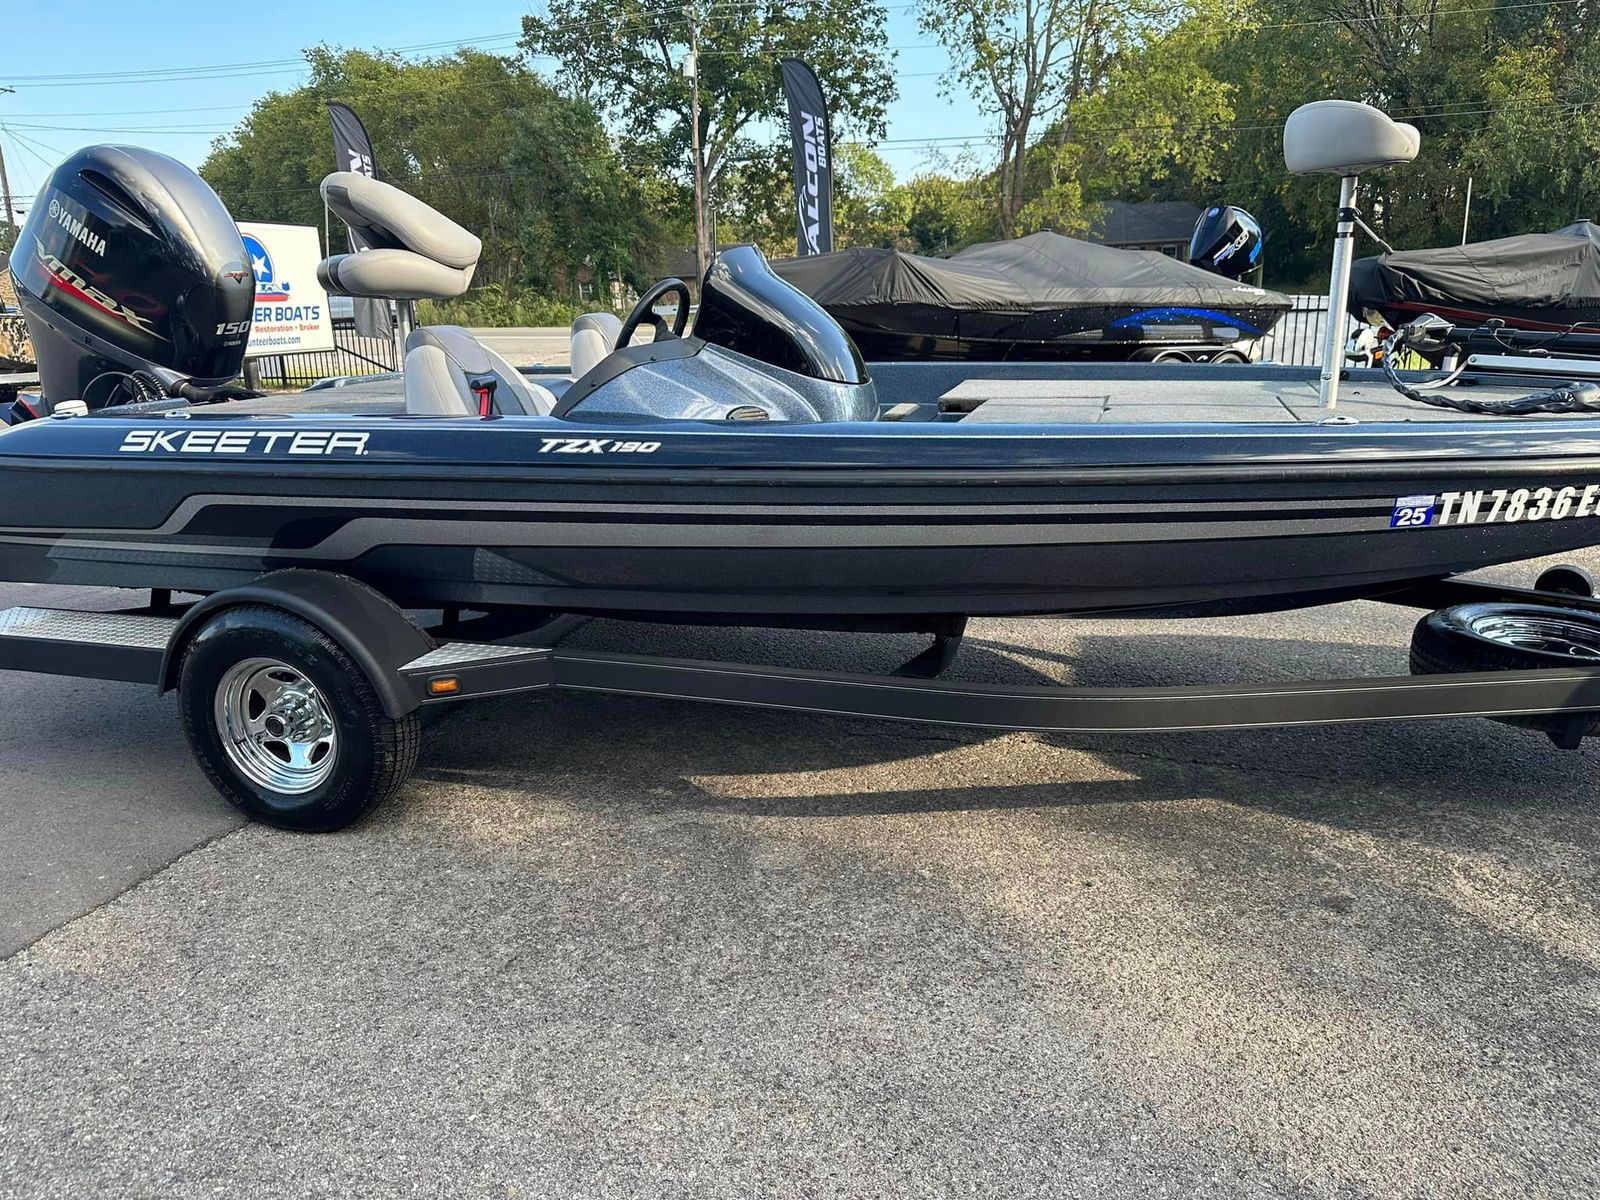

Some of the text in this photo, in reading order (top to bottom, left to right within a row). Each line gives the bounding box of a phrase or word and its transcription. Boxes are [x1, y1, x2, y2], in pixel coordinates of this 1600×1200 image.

[815, 115, 827, 168] BOATS
[57, 205, 107, 257] YAMAHA
[254, 306, 320, 322] ER BOATS
[215, 320, 251, 335] 150
[255, 325, 294, 333] Restoration
[248, 336, 301, 347] unteerboats.com
[537, 438, 662, 454] TZX 190
[1396, 507, 1426, 526] 25
